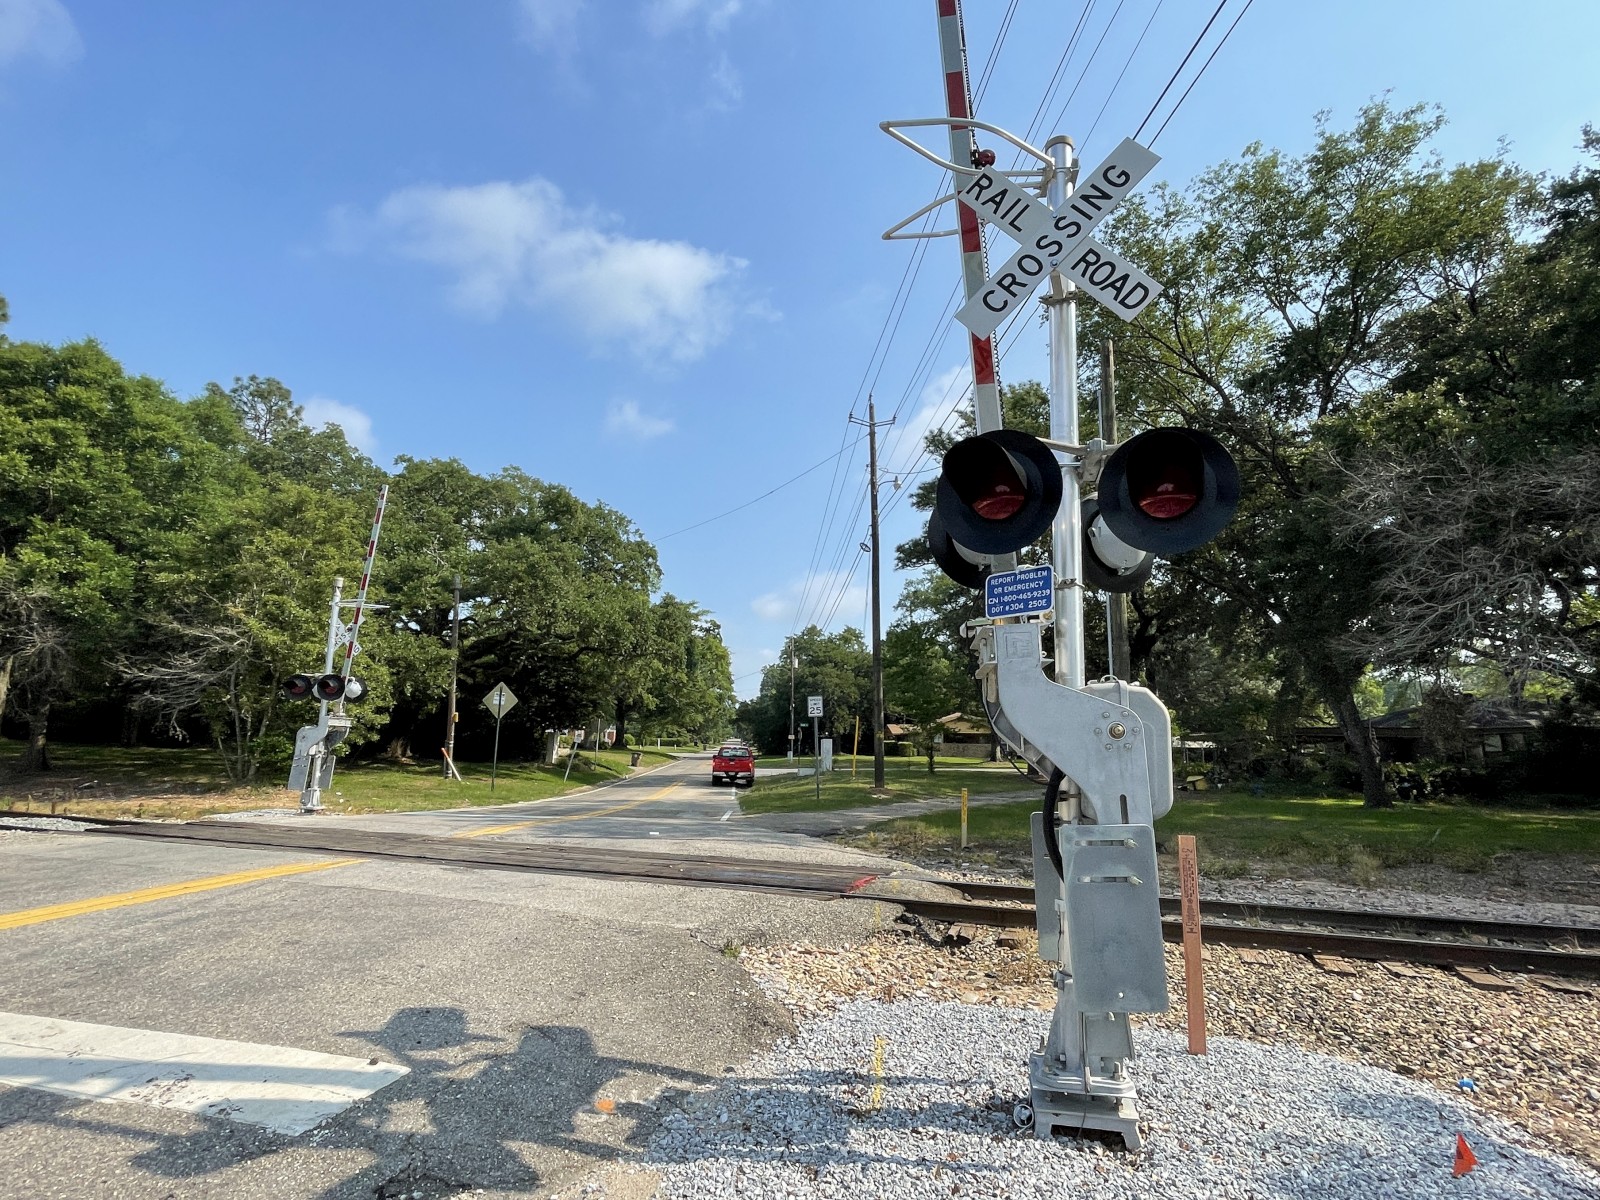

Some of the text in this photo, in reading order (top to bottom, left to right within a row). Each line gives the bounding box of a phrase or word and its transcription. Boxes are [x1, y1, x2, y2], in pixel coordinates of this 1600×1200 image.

[965, 172, 1150, 310] RAIL ROAD
[982, 164, 1131, 313] CROSSING
[991, 570, 1047, 586] REPORT PROBLEM
[993, 581, 1044, 595] OR EMERGENCY
[988, 589, 1051, 605] CN 1-800-465-9239
[991, 605, 1003, 614] DOT
[1005, 602, 1024, 611] #304
[809, 706, 821, 714] 25
